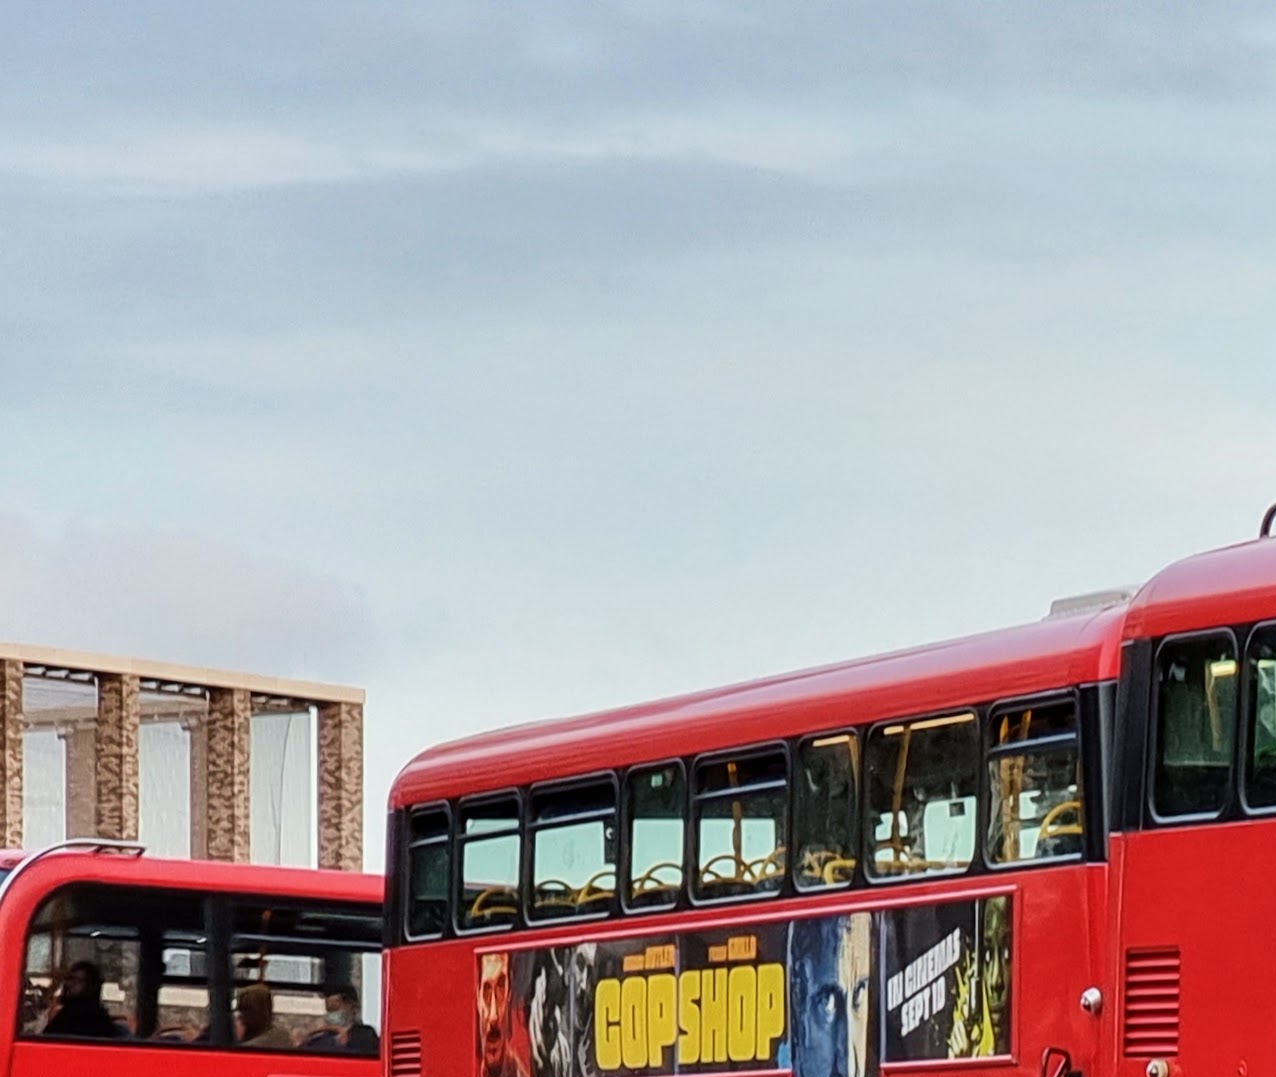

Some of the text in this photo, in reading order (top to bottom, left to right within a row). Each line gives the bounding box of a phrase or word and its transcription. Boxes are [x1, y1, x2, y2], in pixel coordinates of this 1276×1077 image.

[887, 927, 961, 1011] IN CINEMAS
[901, 976, 946, 1037] SEPT 10
[594, 962, 785, 1071] COPSHOP
